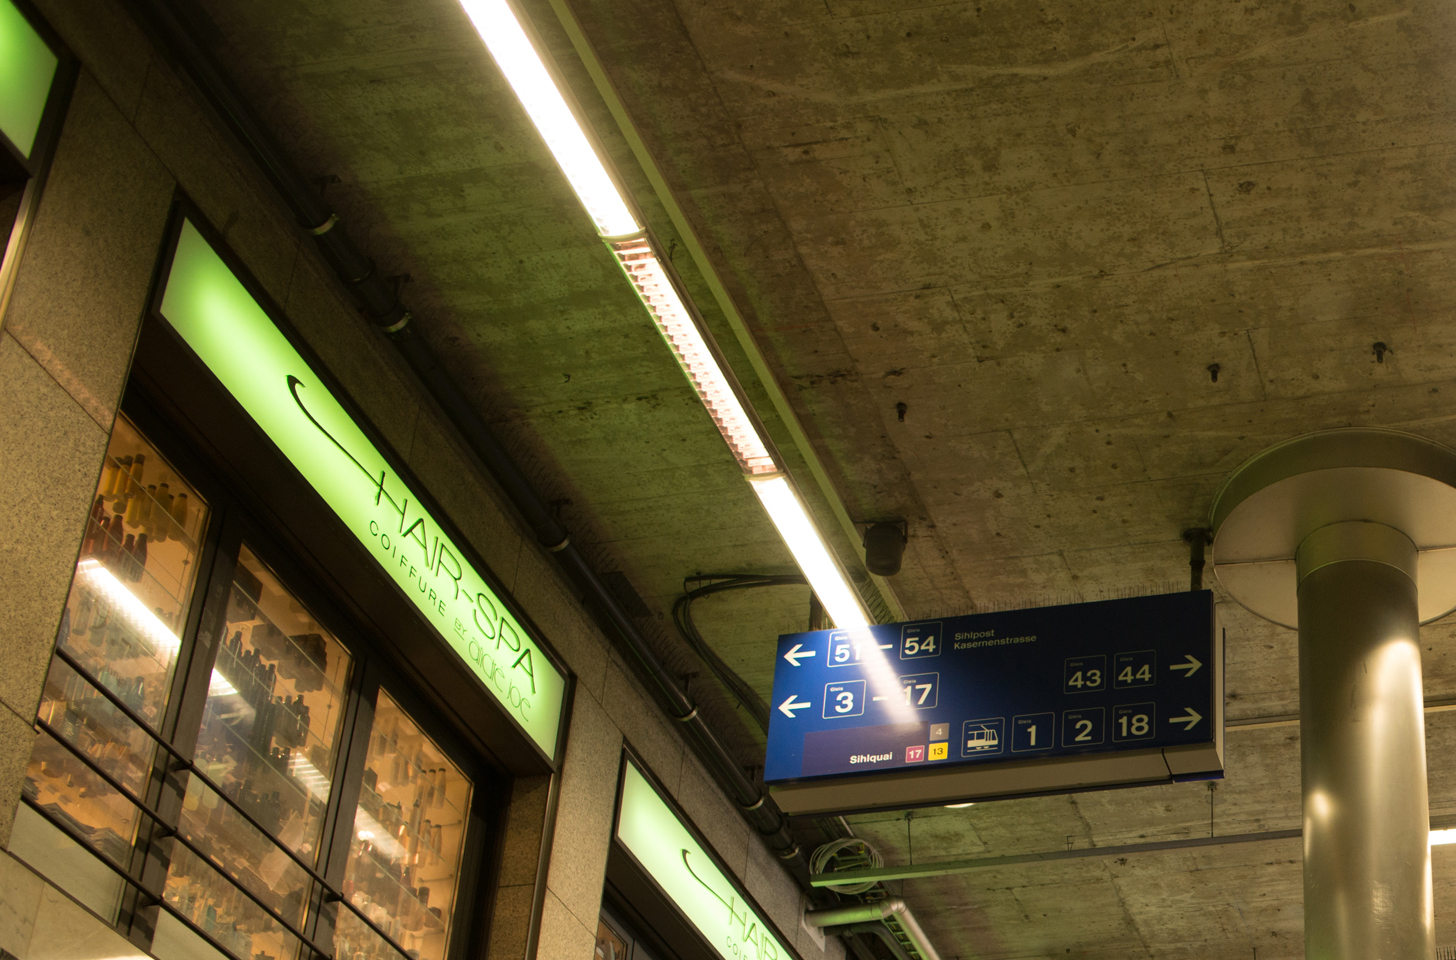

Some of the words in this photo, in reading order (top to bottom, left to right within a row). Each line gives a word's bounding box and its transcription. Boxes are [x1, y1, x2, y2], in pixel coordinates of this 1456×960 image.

[369, 520, 447, 617] COIFFURE
[454, 617, 468, 635] BY
[904, 635, 936, 655] 54
[953, 635, 1037, 650] Kasernenstrasse
[954, 629, 995, 641] Sihlpost
[834, 643, 861, 663] 51
[1068, 669, 1102, 689] 43
[1118, 664, 1152, 684] 44
[834, 691, 854, 713] 3
[903, 683, 932, 706] 17
[935, 728, 943, 736] 4
[1027, 725, 1037, 746] 1
[1074, 719, 1093, 742] 2
[1118, 714, 1149, 737] 18
[849, 752, 893, 765] Sihlquai
[908, 749, 922, 760] 17
[932, 747, 944, 756] 13
